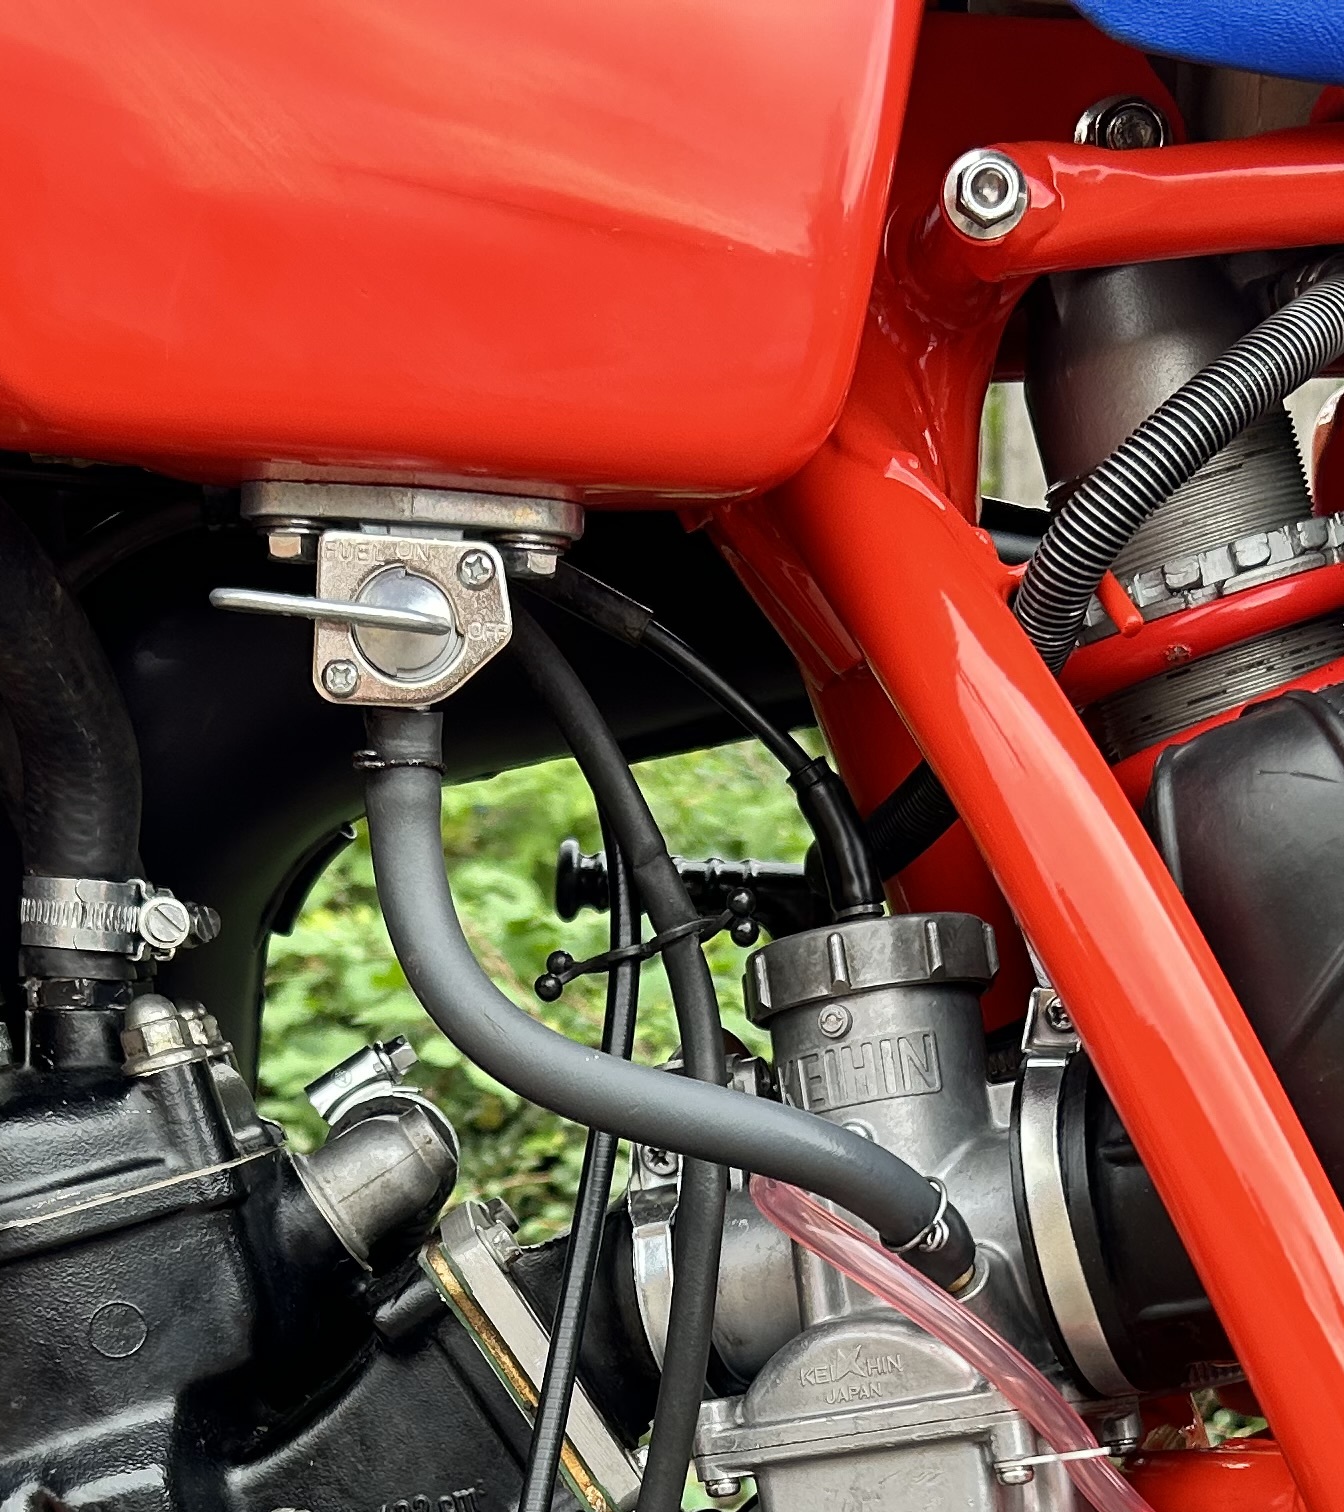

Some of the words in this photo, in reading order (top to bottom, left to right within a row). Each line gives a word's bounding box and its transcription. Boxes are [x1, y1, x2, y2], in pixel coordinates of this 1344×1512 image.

[324, 541, 386, 562] FUEL
[395, 541, 430, 561] ON
[467, 621, 508, 641] OFF
[777, 1033, 940, 1112] KEIHIN
[825, 1382, 883, 1404] JAPAN
